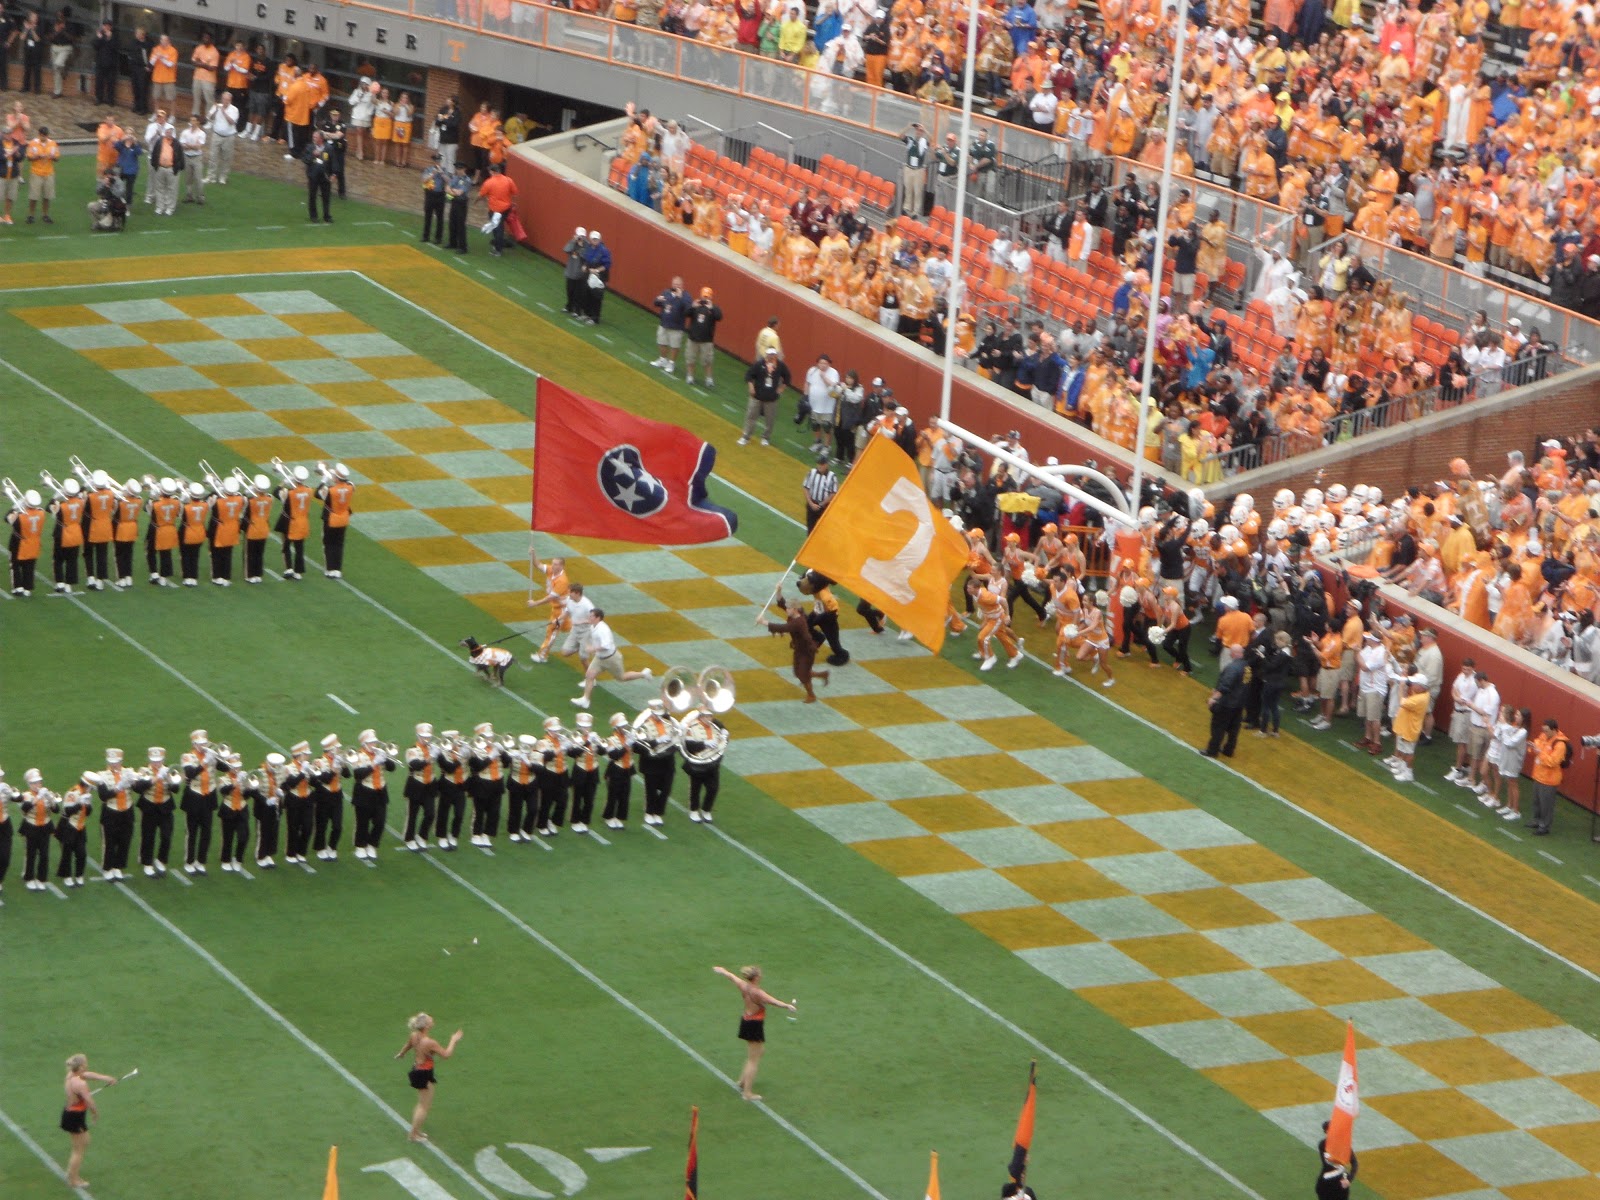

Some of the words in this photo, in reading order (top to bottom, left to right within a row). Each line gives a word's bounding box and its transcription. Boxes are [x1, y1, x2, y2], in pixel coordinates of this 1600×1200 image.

[256, 2, 418, 51] CENTER
[447, 39, 466, 63] T
[98, 495, 110, 510] T
[296, 492, 309, 510] T
[337, 487, 349, 503] T
[68, 503, 81, 520] T
[126, 503, 139, 520] T
[161, 504, 175, 521] T
[191, 506, 204, 521] T
[226, 501, 239, 517] T
[256, 501, 269, 517] T
[29, 516, 41, 533] T
